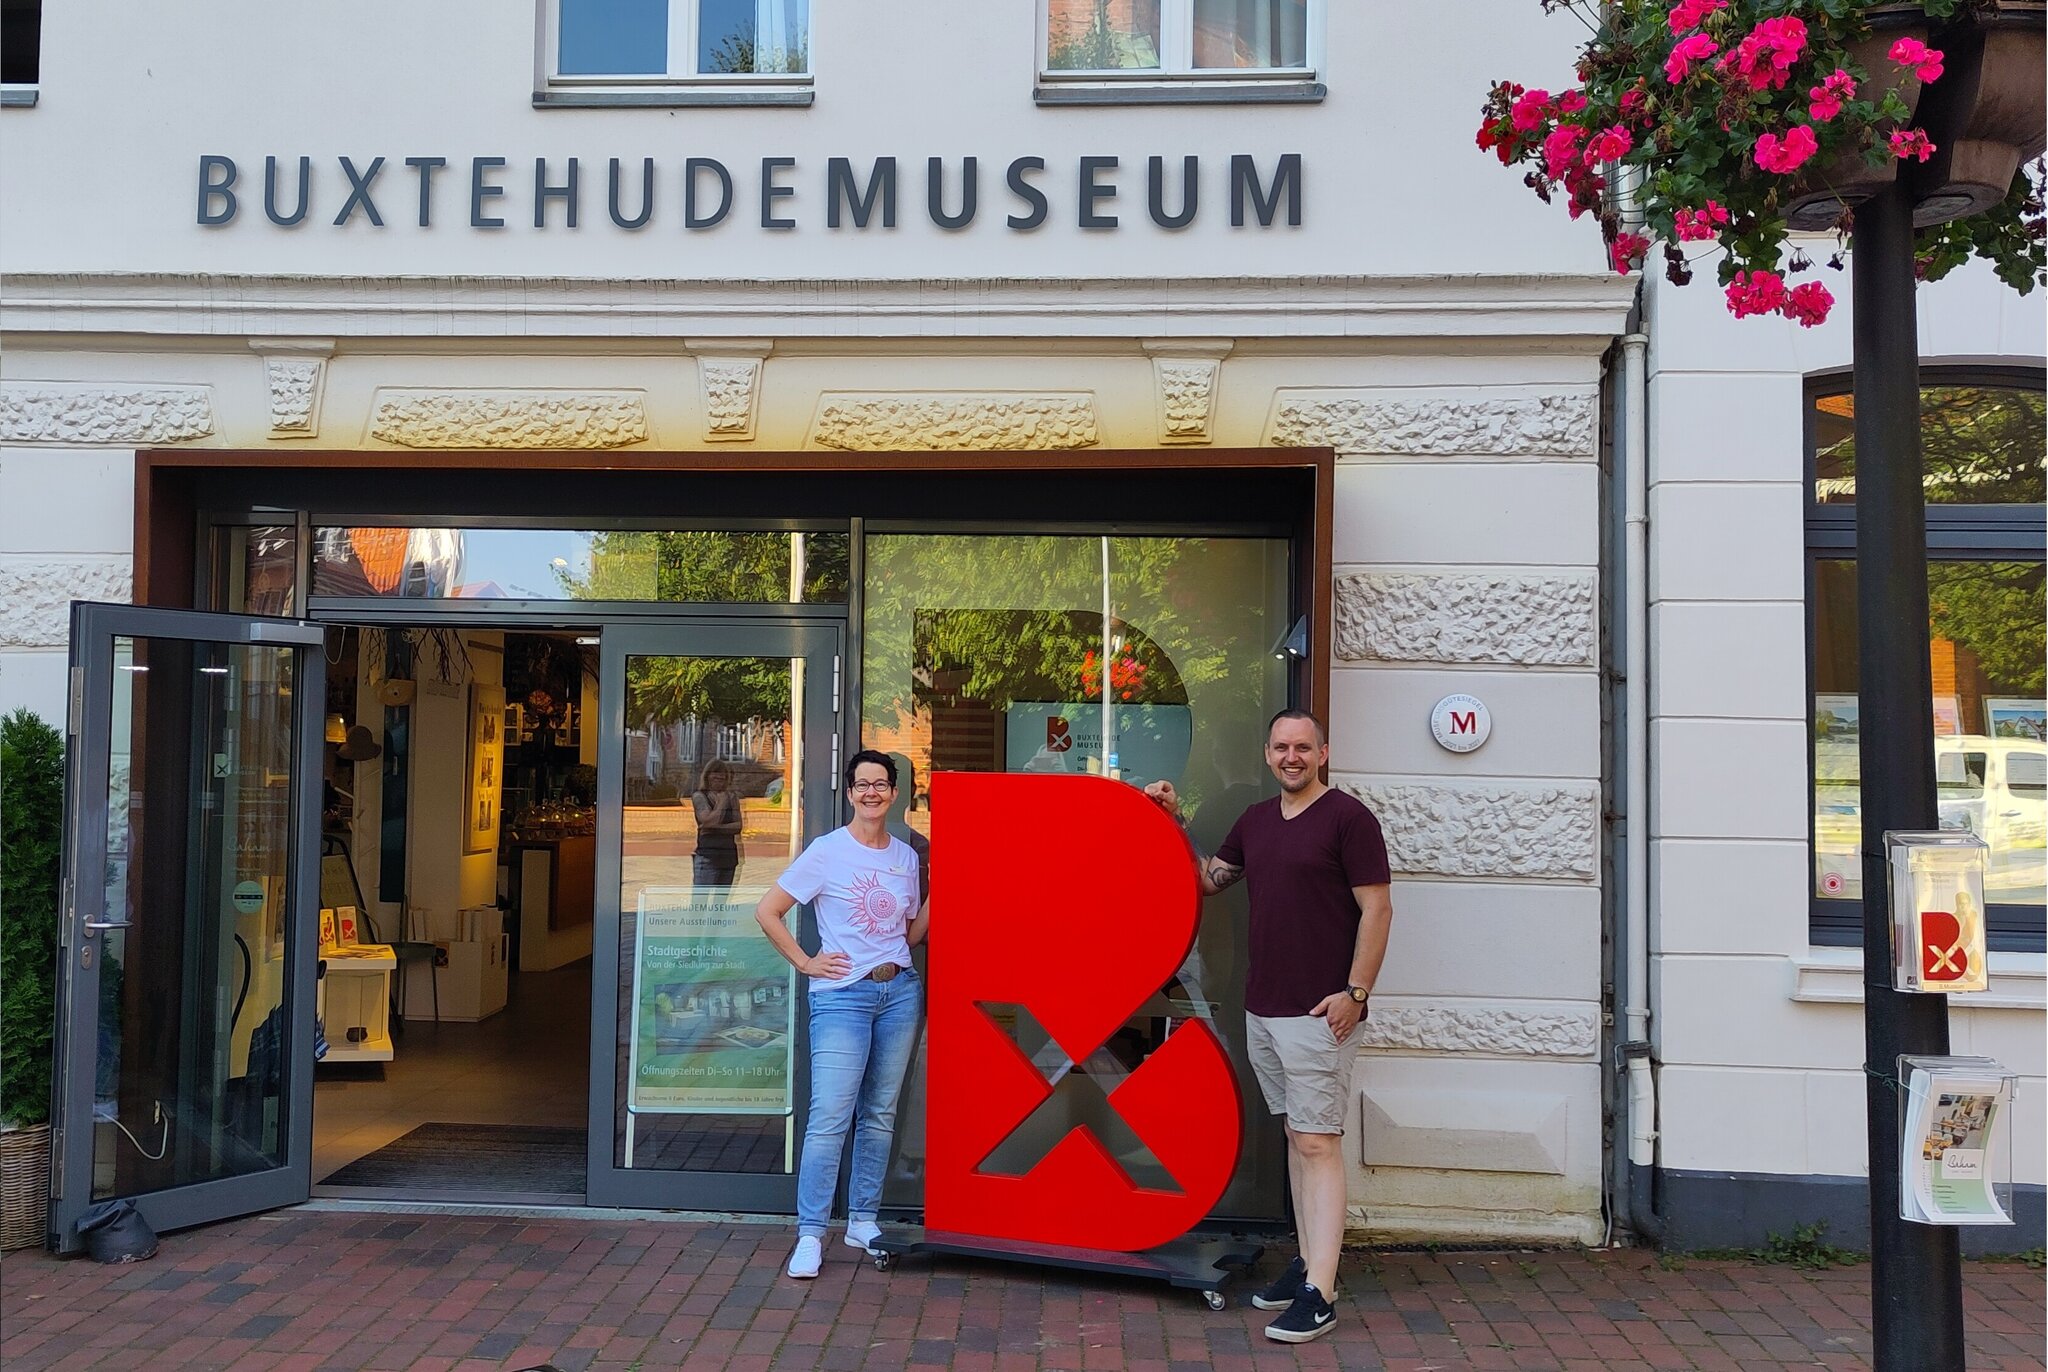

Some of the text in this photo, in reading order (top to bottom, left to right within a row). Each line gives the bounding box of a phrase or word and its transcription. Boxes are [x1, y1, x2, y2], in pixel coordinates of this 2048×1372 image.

[197, 154, 1302, 228] BUXTEHUDEMUSEUM
[1448, 711, 1476, 735] M
[648, 916, 737, 928] Unsere Ausstellungen
[647, 945, 728, 959] Stadtgeschichte
[647, 960, 746, 971] Von der Siedlung zur Stadt
[641, 1064, 705, 1078] Öffnungszeiten
[765, 1067, 781, 1078] Uhr
